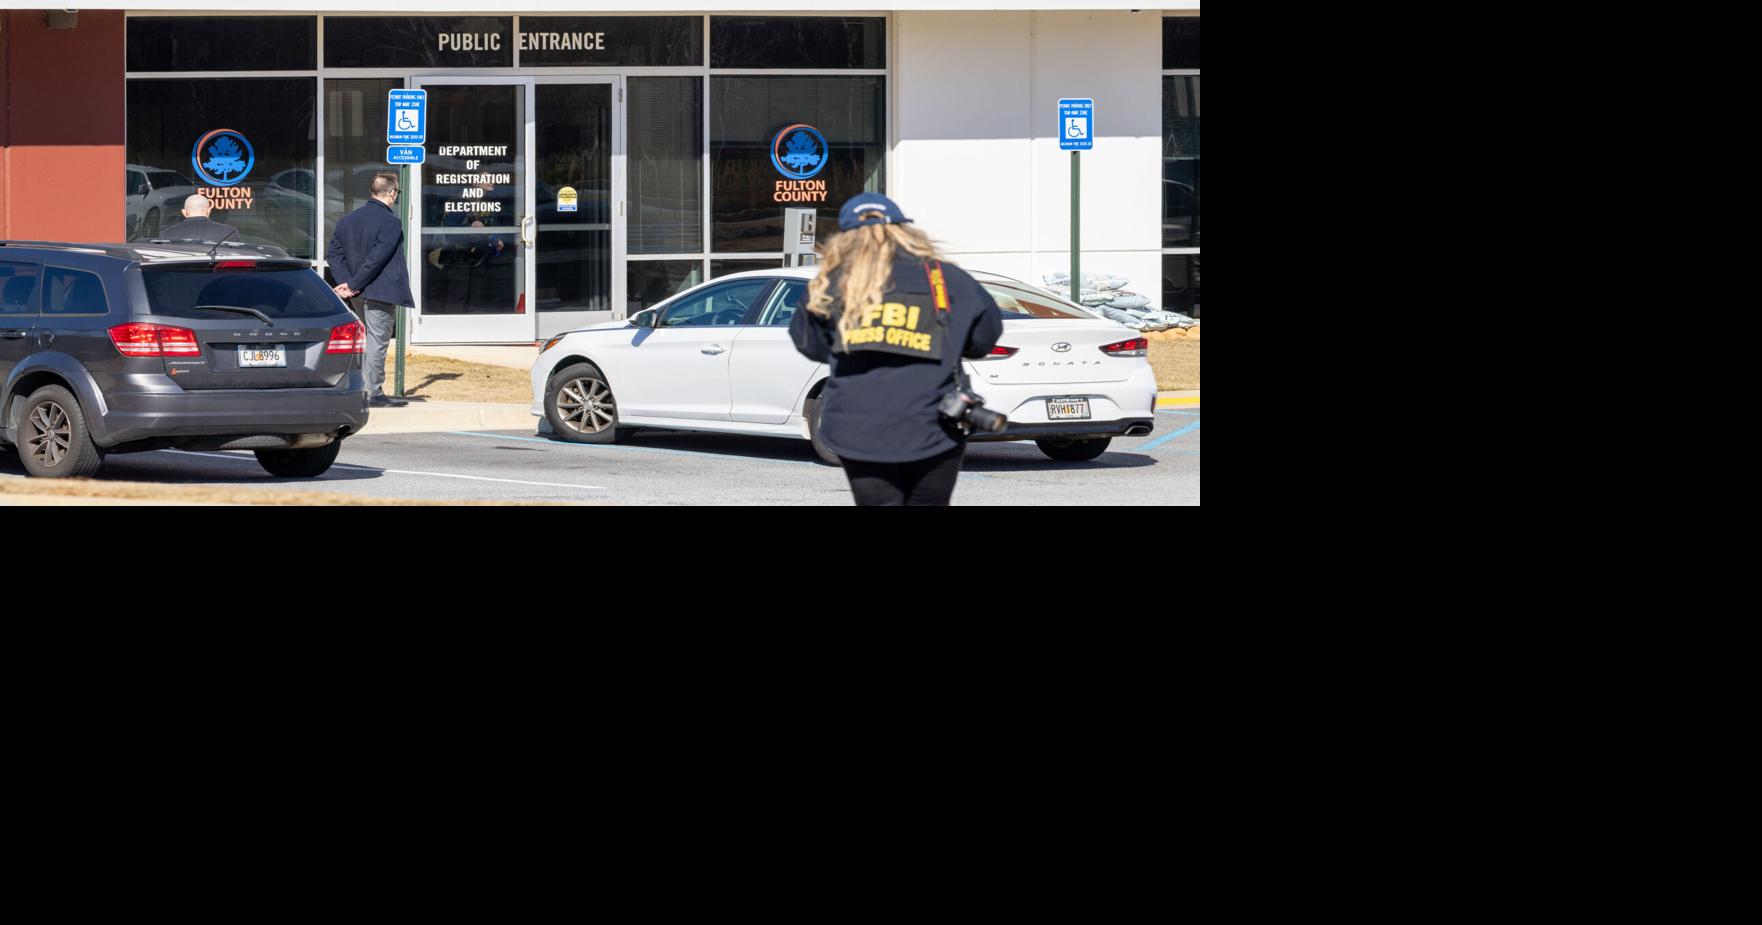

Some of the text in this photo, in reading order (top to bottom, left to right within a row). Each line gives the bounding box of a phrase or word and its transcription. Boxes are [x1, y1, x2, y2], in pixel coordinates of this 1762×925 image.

[438, 32, 605, 51] PUBLIC ENTRANCE
[439, 146, 507, 156] DEPARTMENT
[466, 160, 480, 170] OF
[436, 174, 510, 184] REGISTRATION
[775, 180, 826, 191] FULTON
[197, 187, 251, 198] FULTON
[462, 188, 484, 198] AND
[773, 191, 828, 202] COUNTY
[208, 198, 253, 209] OUNTY
[445, 202, 501, 212] ELECTIONS
[861, 302, 920, 331] FBI
[847, 326, 932, 352] PRESS OFFICE
